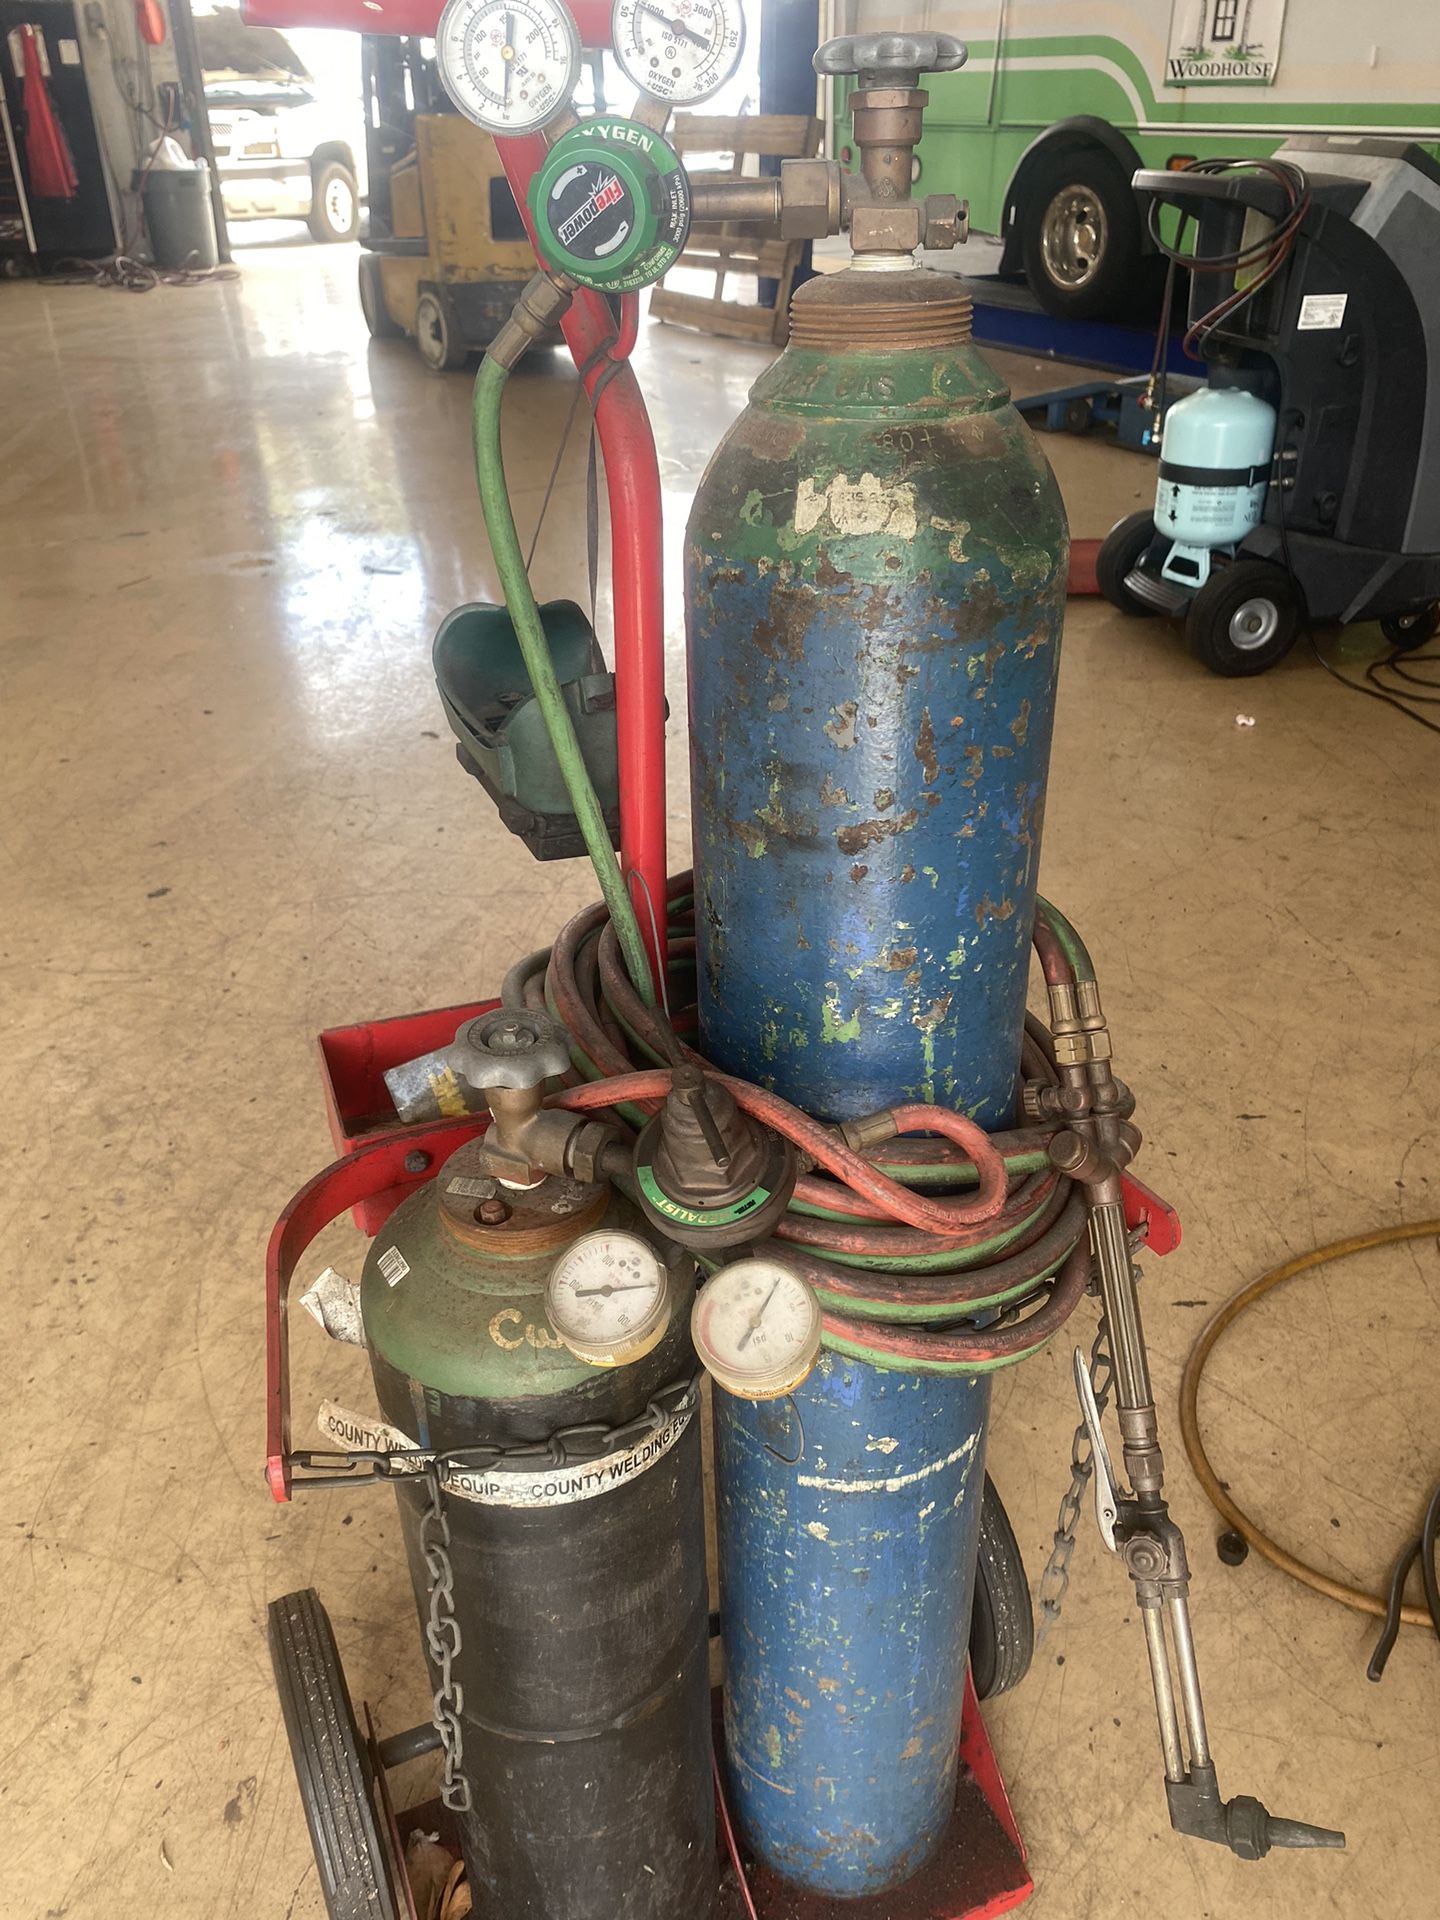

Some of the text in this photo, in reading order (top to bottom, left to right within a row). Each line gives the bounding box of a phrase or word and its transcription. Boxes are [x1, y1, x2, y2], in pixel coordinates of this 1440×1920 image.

[620, 5, 630, 18] 50
[647, 3, 665, 16] 1000
[693, 3, 713, 19] 3000
[474, 30, 487, 44] 100
[525, 28, 540, 44] 200
[661, 31, 688, 48] ISO 5171
[729, 30, 738, 48] 250
[479, 67, 489, 78] 50
[648, 70, 676, 88] OXYGEN
[704, 73, 719, 88] 300
[528, 84, 552, 108] OXYGEN
[571, 125, 654, 153] XYGEN
[560, 177, 624, 245] Firepower
[657, 257, 667, 268] STD
[655, 1199, 730, 1223] EDALIST
[602, 1254, 615, 1267] 400
[328, 1415, 381, 1452] COUNTY
[451, 1475, 500, 1496] EQUIP
[531, 1469, 605, 1498] COUNTY
[609, 1428, 670, 1480] WELDING
